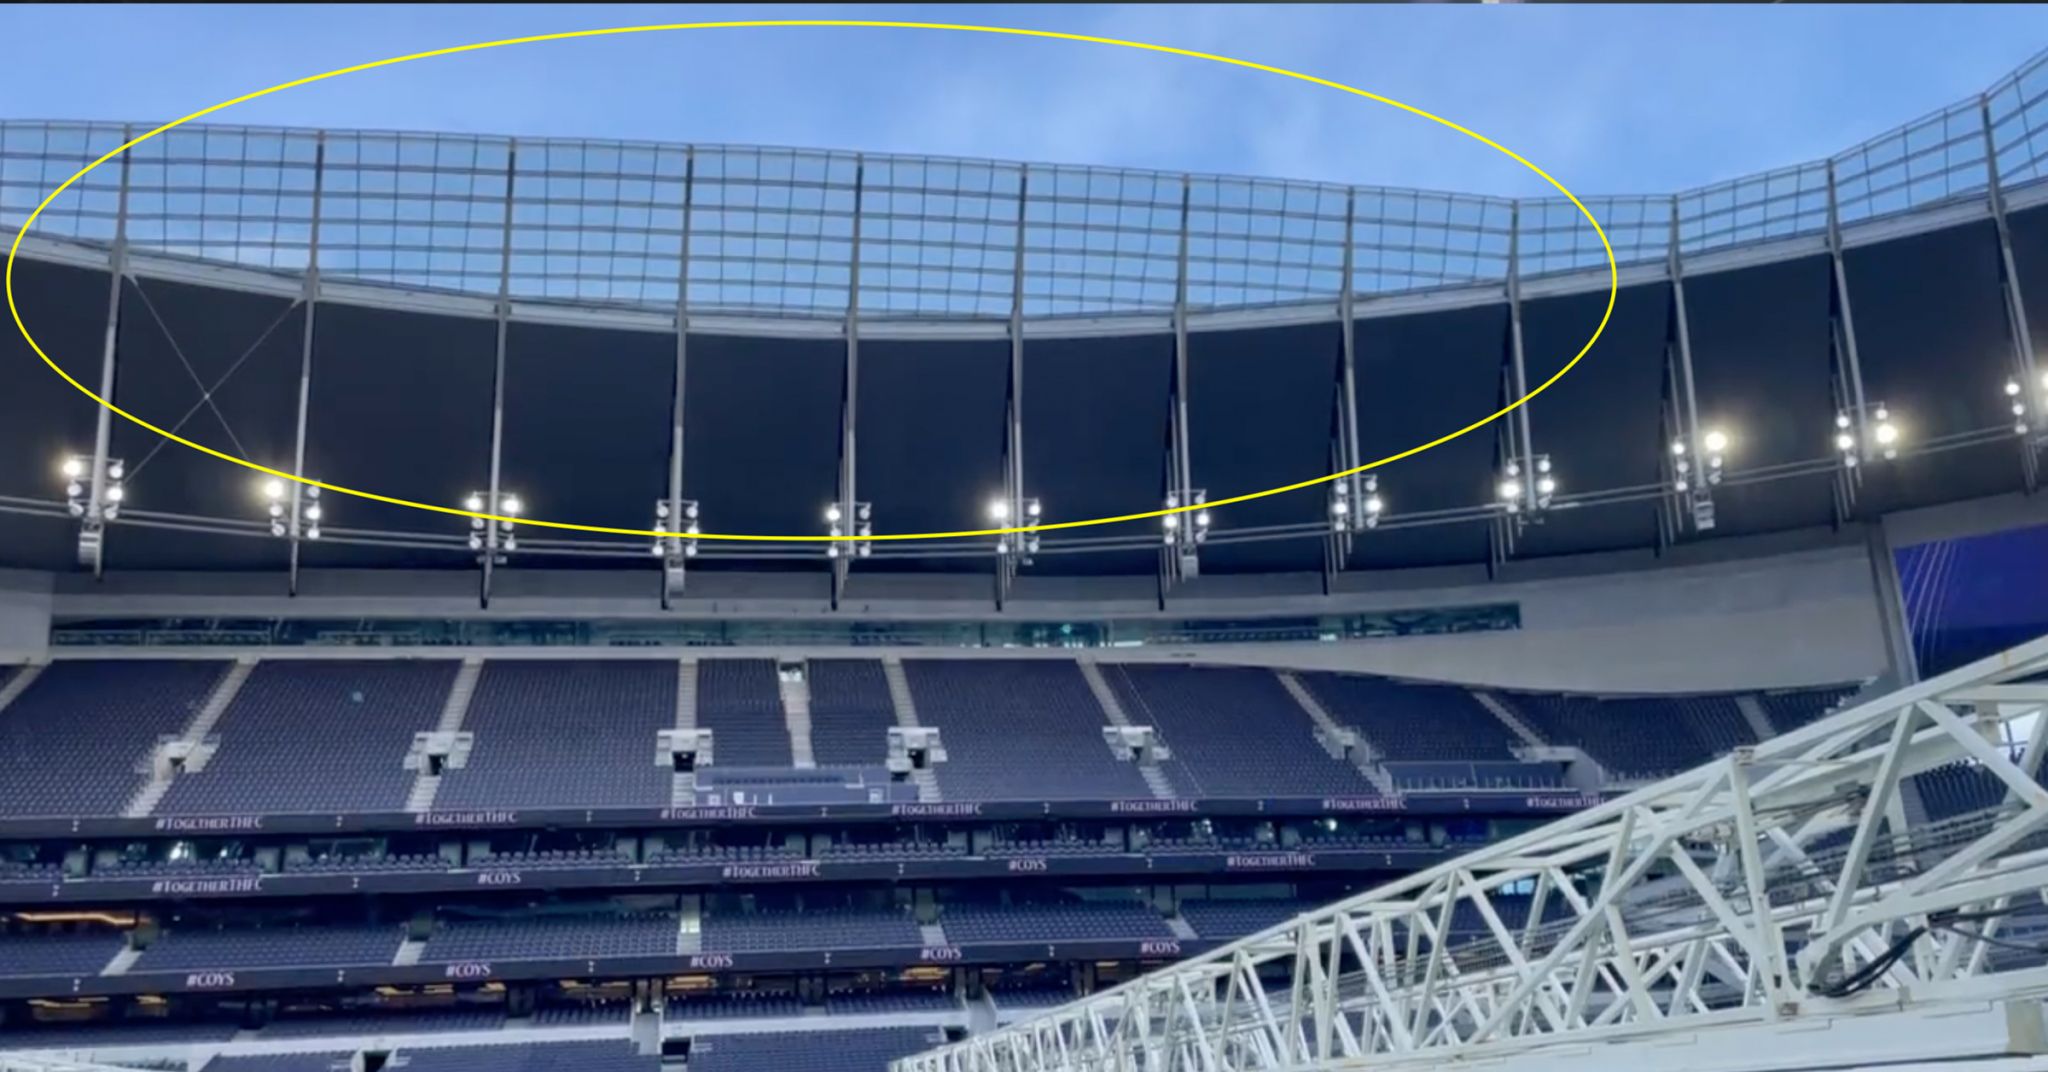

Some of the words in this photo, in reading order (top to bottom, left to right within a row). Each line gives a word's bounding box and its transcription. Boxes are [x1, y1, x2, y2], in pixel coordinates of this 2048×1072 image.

[1009, 860, 1046, 871] #COYS
[479, 872, 521, 884] #COYS
[922, 948, 962, 960] #COYS
[1142, 942, 1180, 954] #COYS
[691, 955, 733, 967] #COYS
[447, 965, 491, 977] #COYS
[187, 974, 235, 986] #COYS
